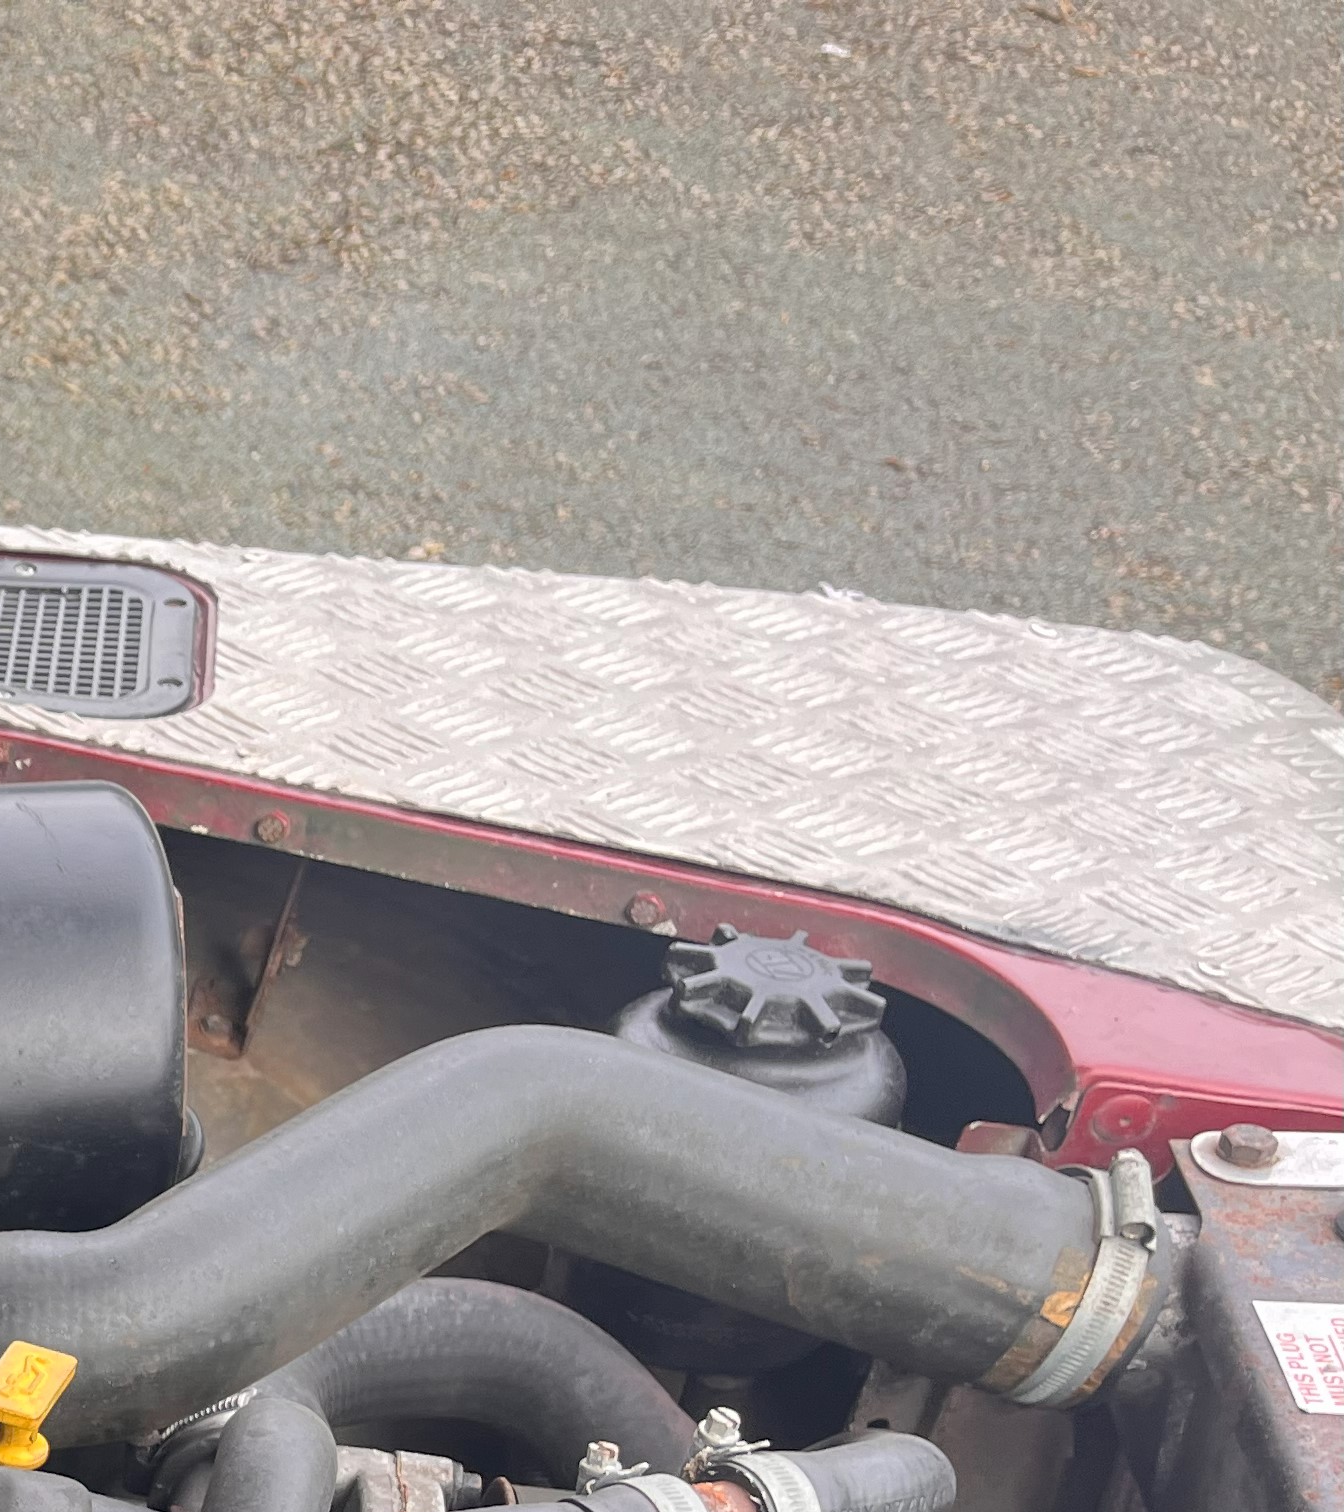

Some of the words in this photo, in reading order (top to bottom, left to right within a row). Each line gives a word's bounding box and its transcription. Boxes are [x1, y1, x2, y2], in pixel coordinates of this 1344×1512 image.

[1275, 1332, 1308, 1369] PLUG
[1304, 1334, 1334, 1363] NOT
[1293, 1373, 1324, 1405] THIS
